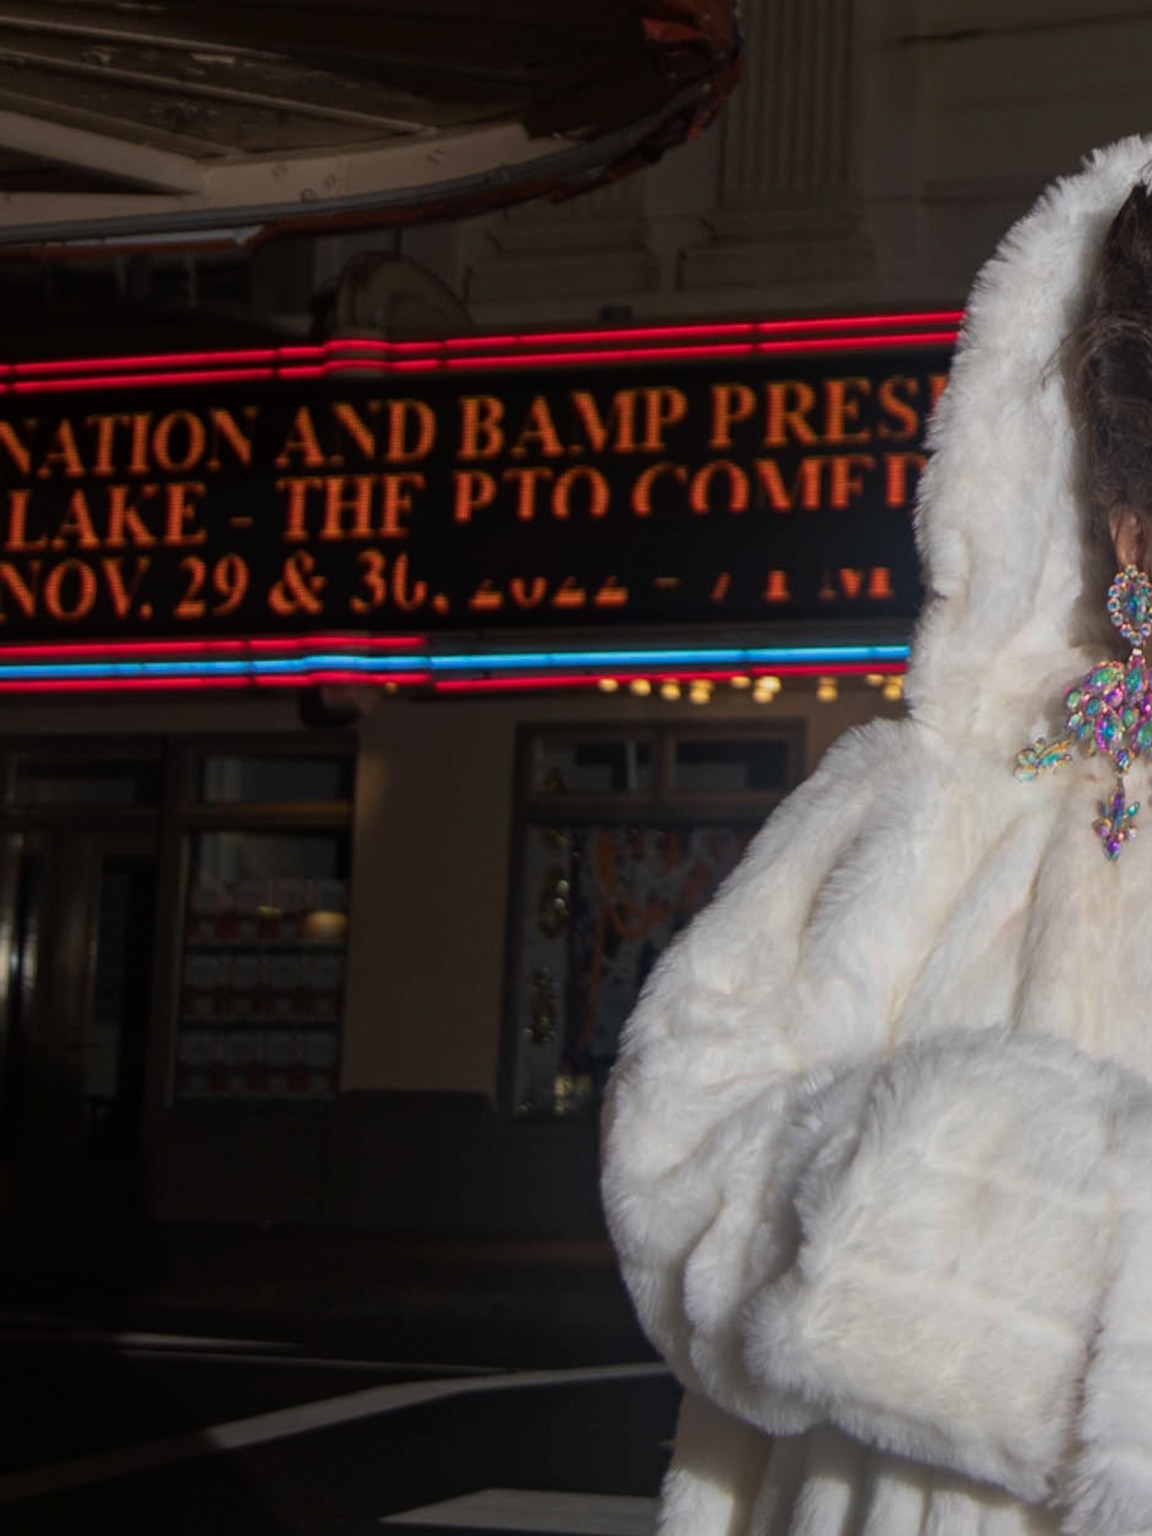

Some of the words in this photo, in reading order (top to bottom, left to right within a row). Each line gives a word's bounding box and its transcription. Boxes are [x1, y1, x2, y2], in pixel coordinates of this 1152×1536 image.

[274, 398, 437, 468] AND
[457, 384, 689, 461] BAMP
[708, 373, 952, 450] PRES
[173, 552, 249, 619] 29
[269, 548, 327, 616] &
